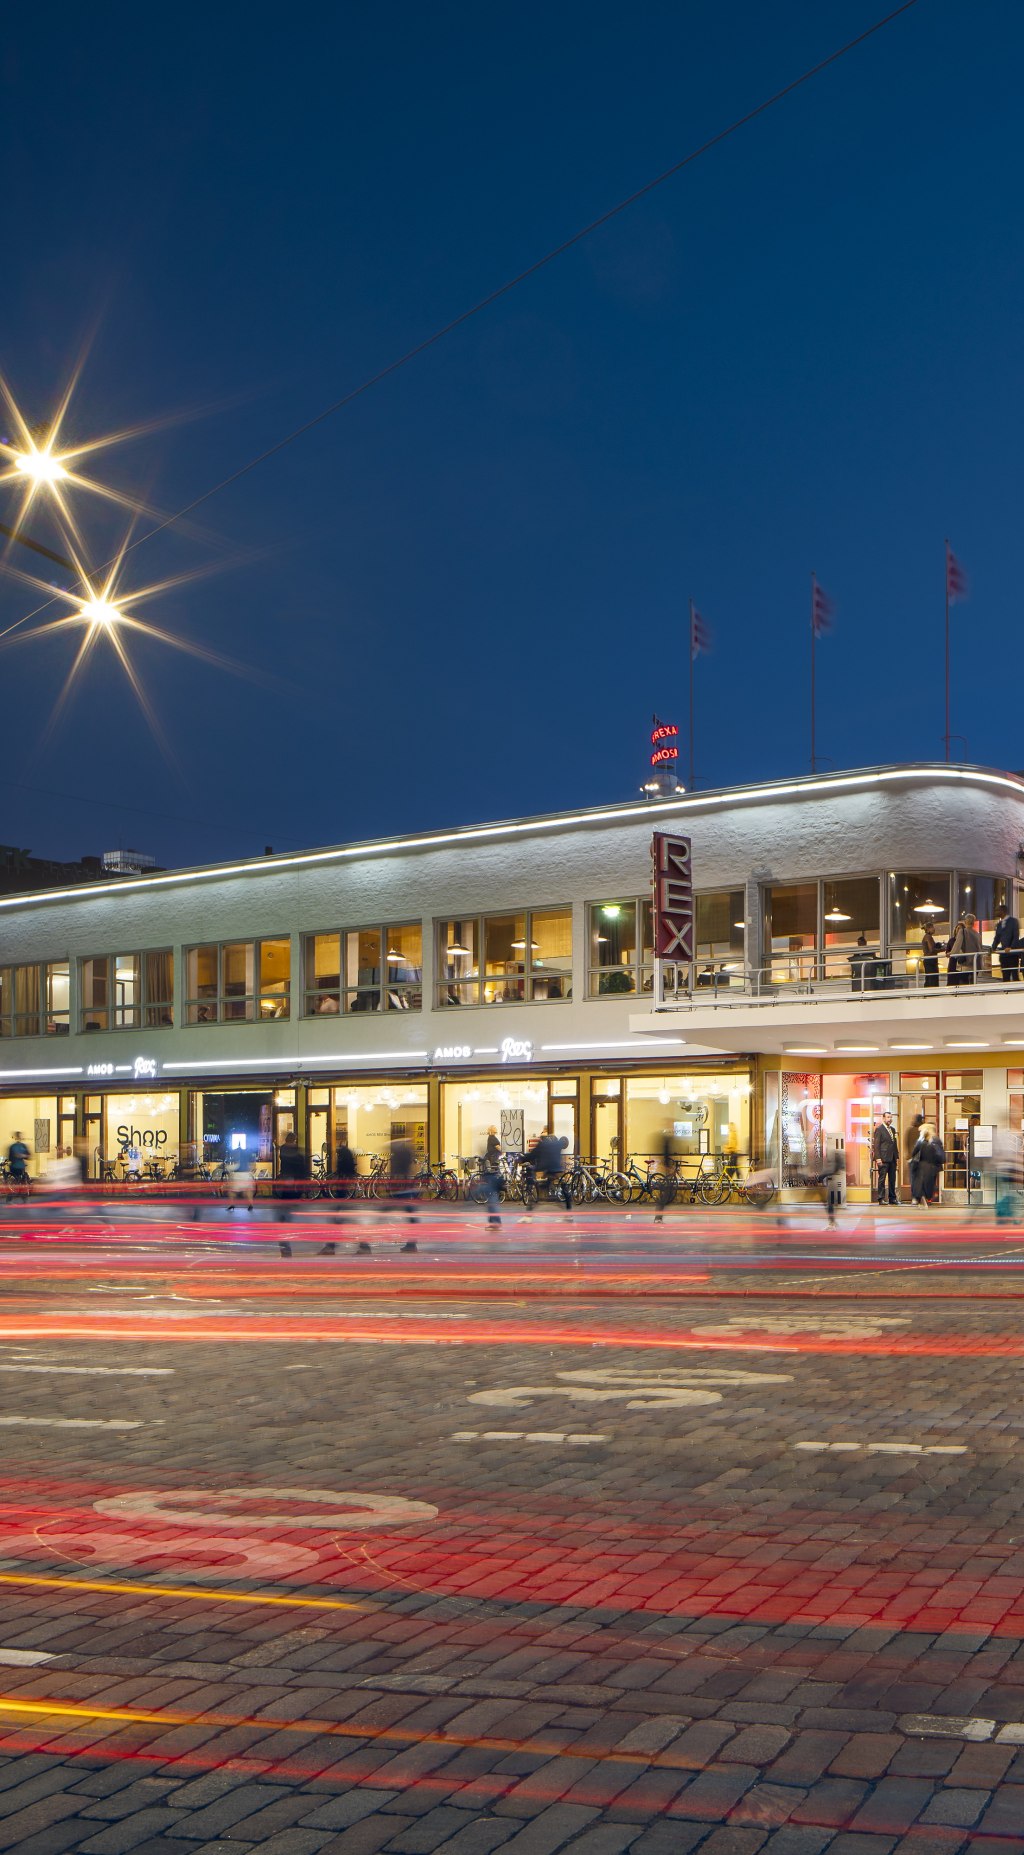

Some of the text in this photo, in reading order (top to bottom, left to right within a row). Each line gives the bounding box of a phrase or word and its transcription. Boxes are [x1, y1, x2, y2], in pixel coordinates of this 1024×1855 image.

[661, 837, 692, 956] REX
[435, 1037, 532, 1062] AMOS Rex
[88, 1063, 114, 1075] AMOS
[117, 1125, 168, 1149] Shop
